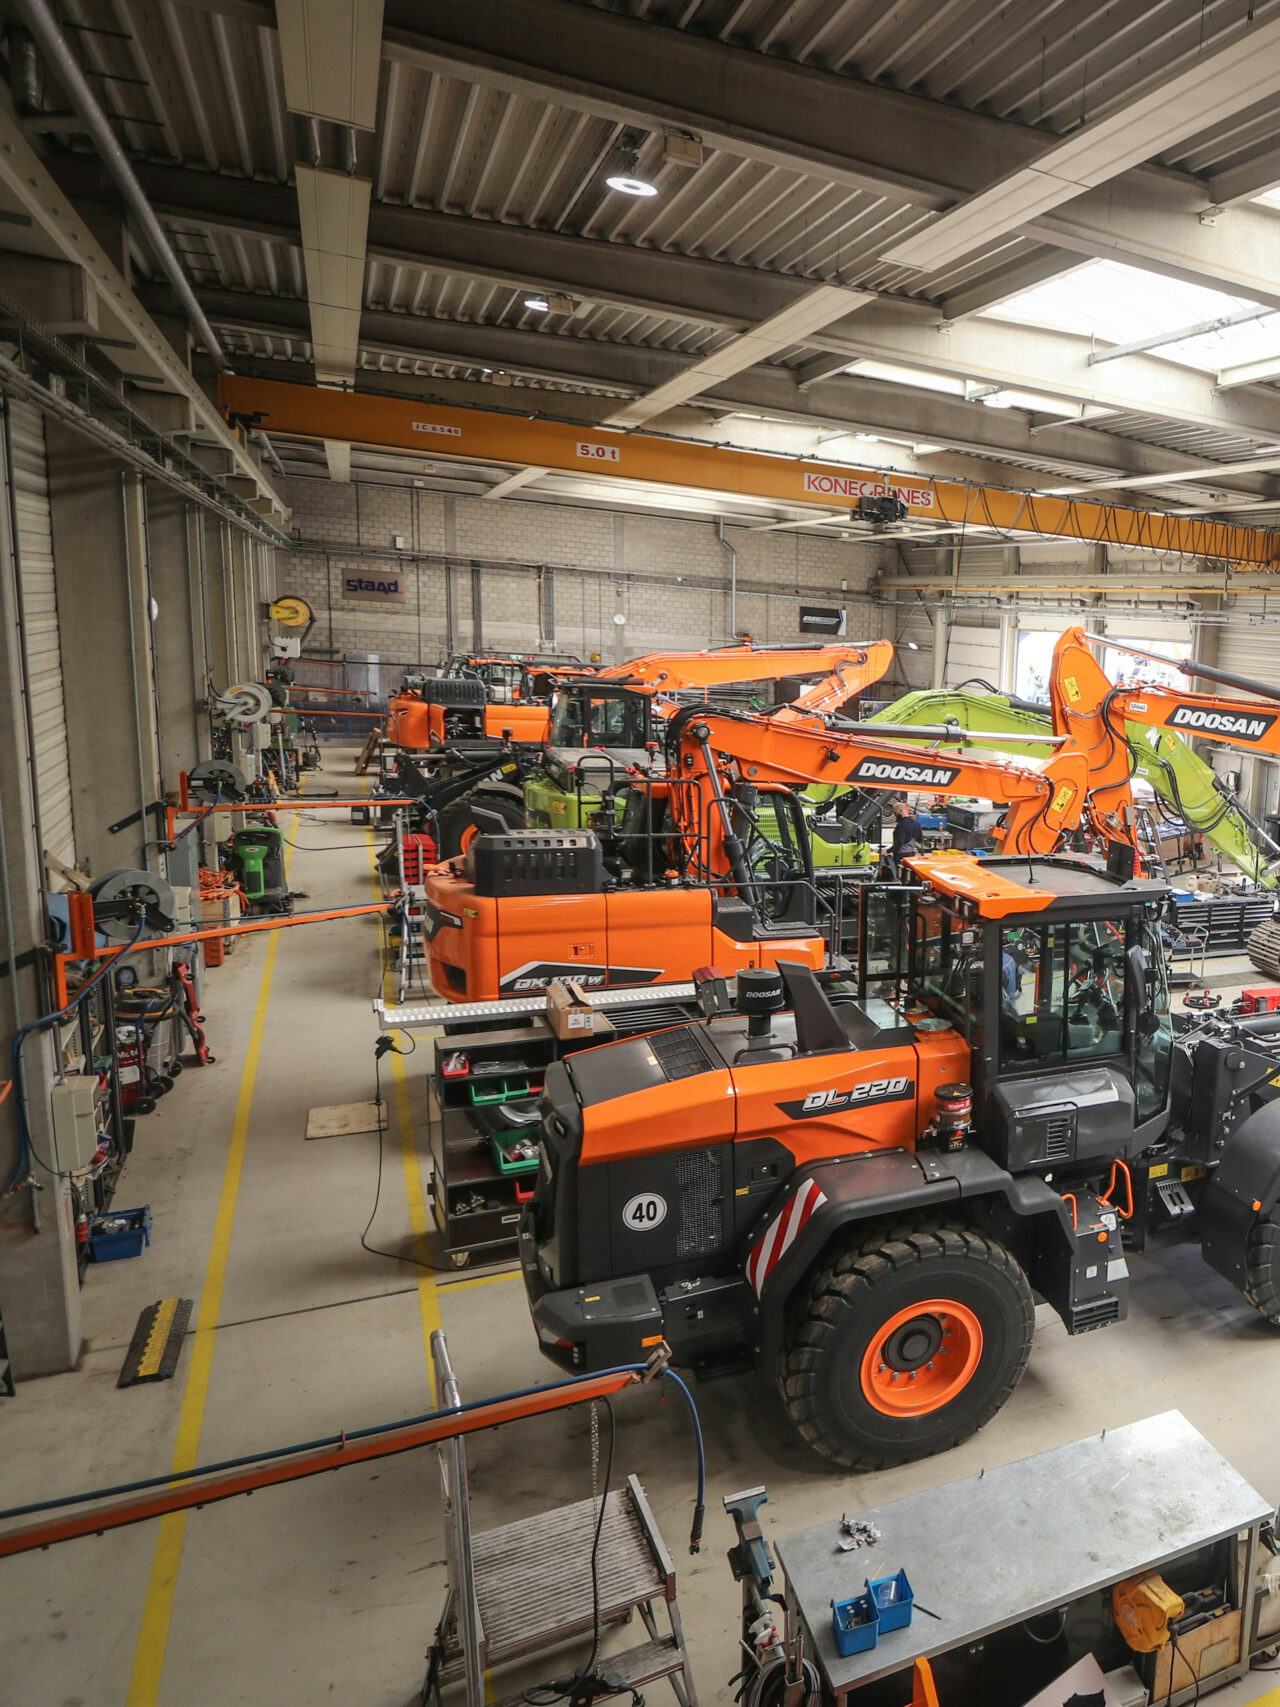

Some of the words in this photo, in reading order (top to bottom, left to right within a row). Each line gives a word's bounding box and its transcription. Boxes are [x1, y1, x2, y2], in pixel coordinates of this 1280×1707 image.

[580, 444, 605, 458] 5.0
[611, 449, 617, 460] t
[1173, 708, 1267, 736] DOOSAN
[858, 762, 952, 784] DOOSAN
[745, 989, 781, 998] DOOSAN
[802, 1088, 848, 1111] DL
[850, 1076, 910, 1102] 220
[631, 1200, 657, 1223] 40
